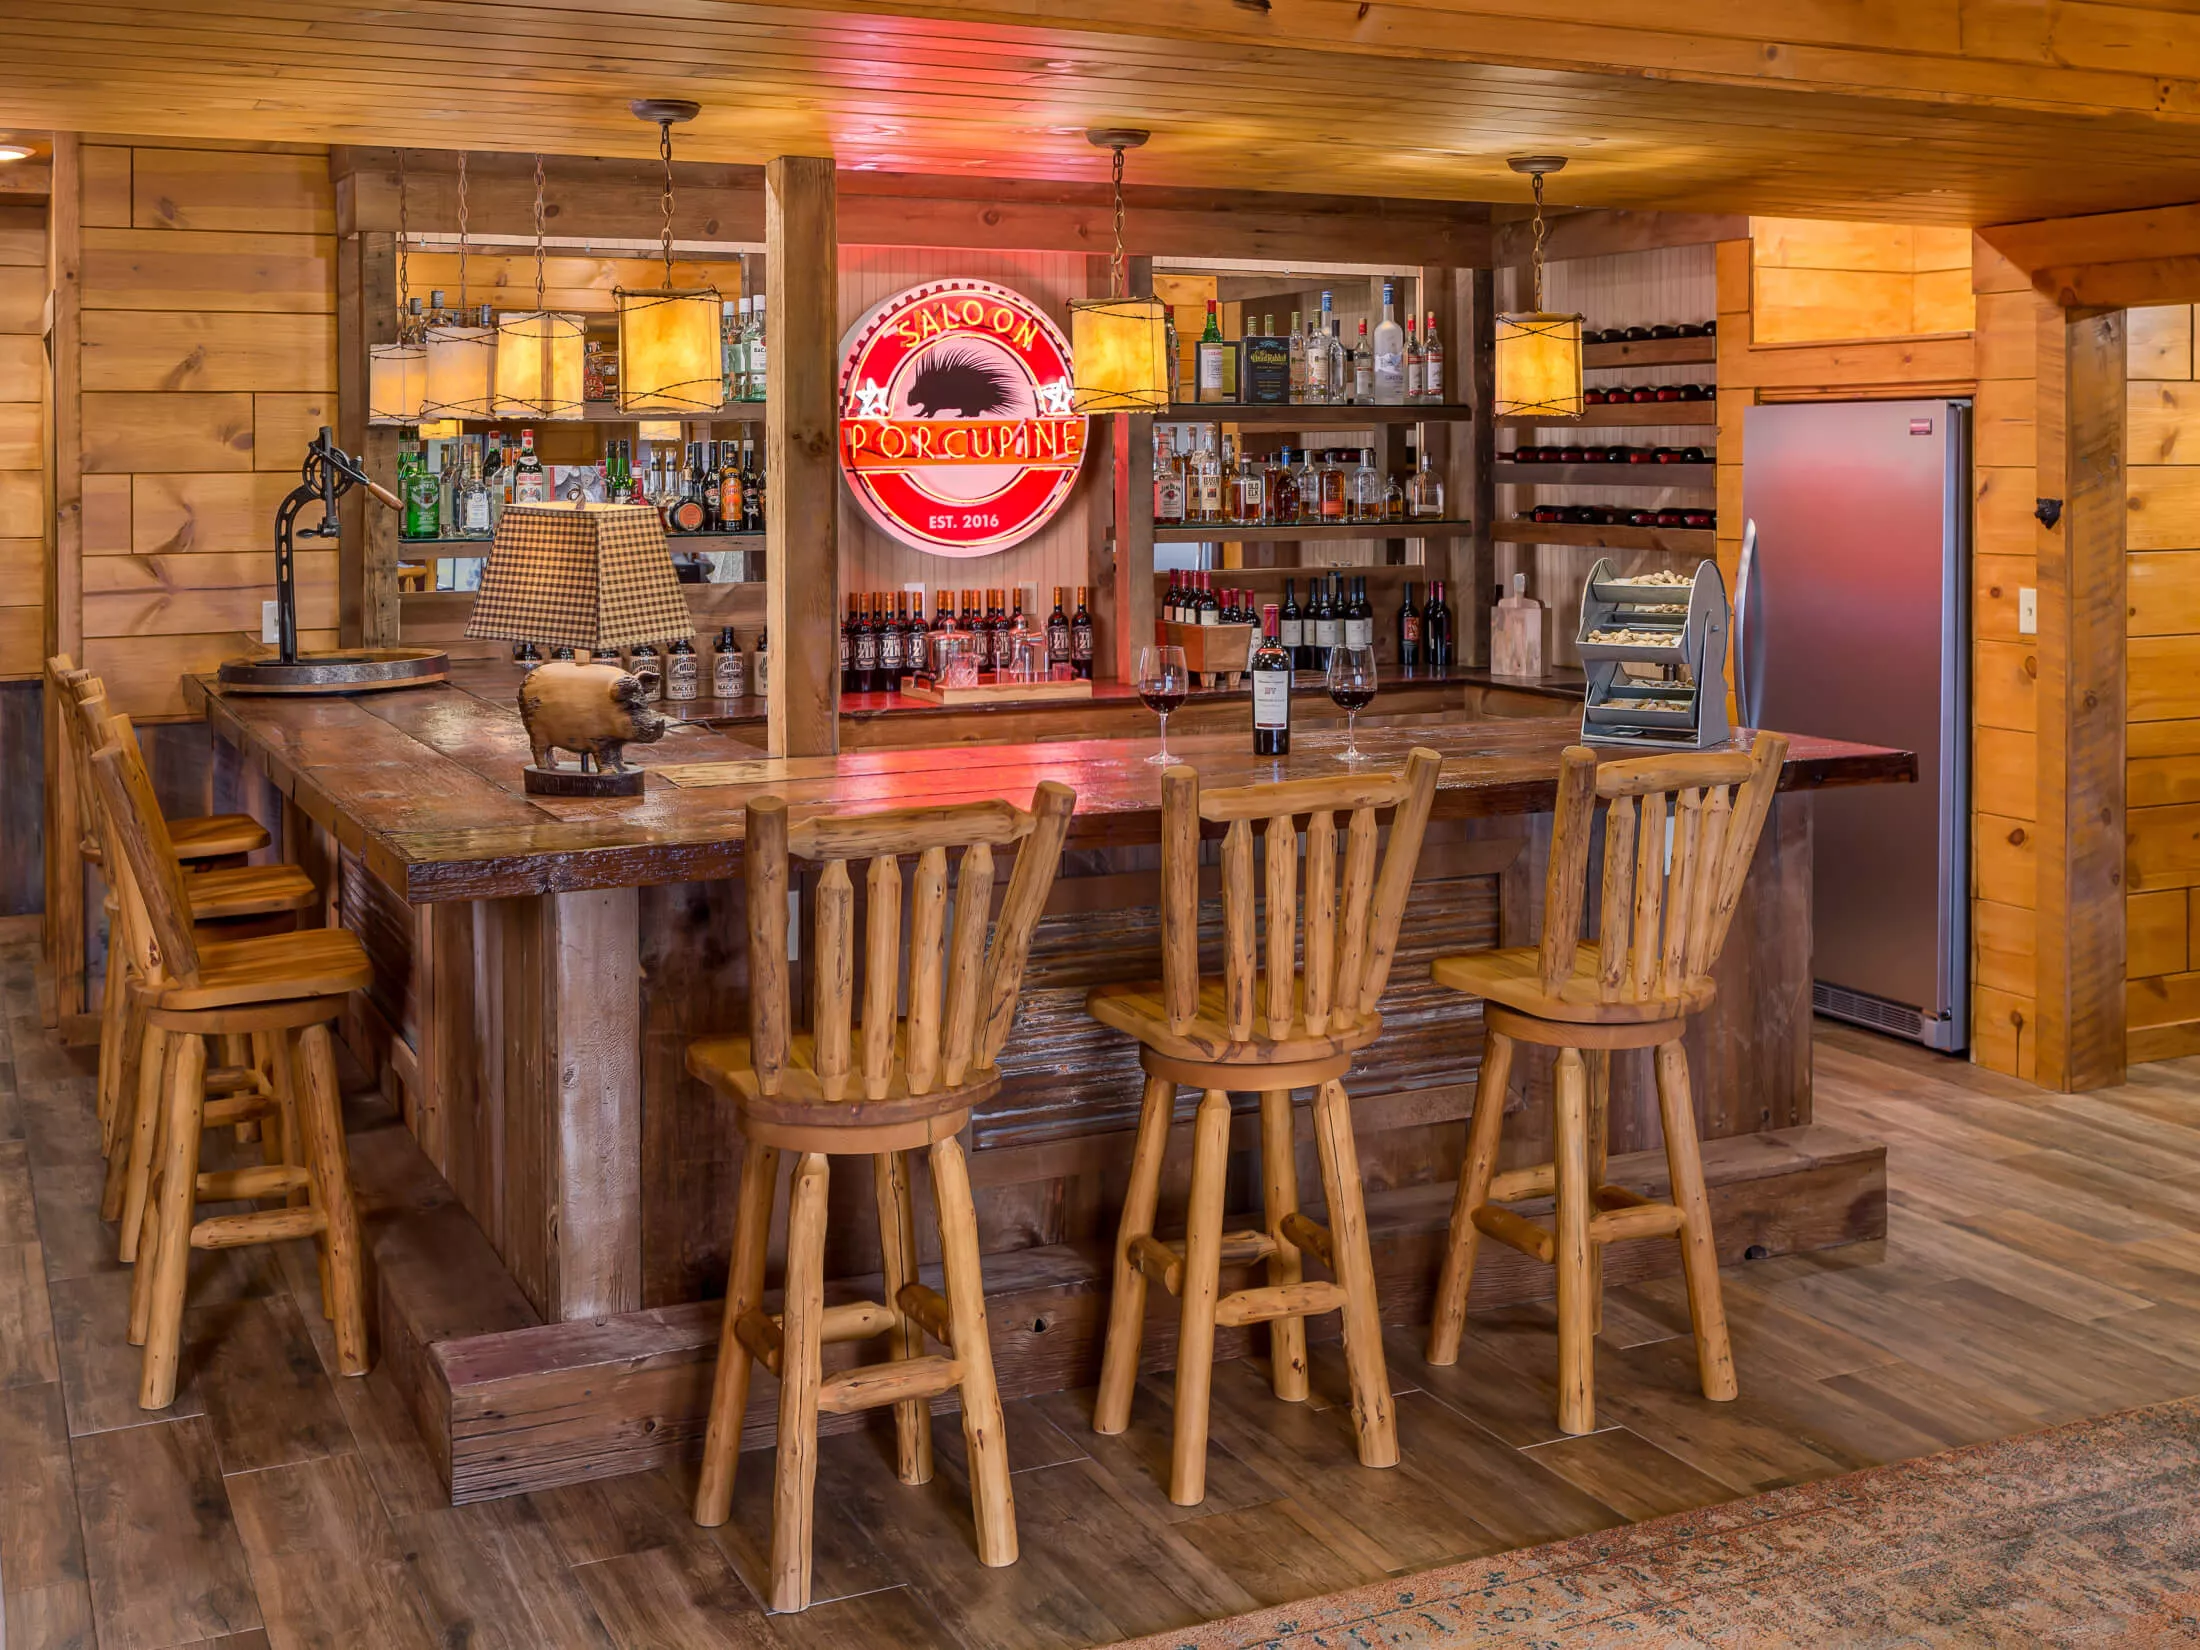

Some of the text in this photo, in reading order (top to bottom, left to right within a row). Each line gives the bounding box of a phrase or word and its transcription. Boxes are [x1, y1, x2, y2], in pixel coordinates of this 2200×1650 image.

[899, 300, 1039, 348] SALOON
[851, 421, 1079, 459] PORCUPINE
[1247, 482, 1259, 490] OLD
[929, 514, 999, 529] EST. 2016
[679, 662, 696, 671] MUD
